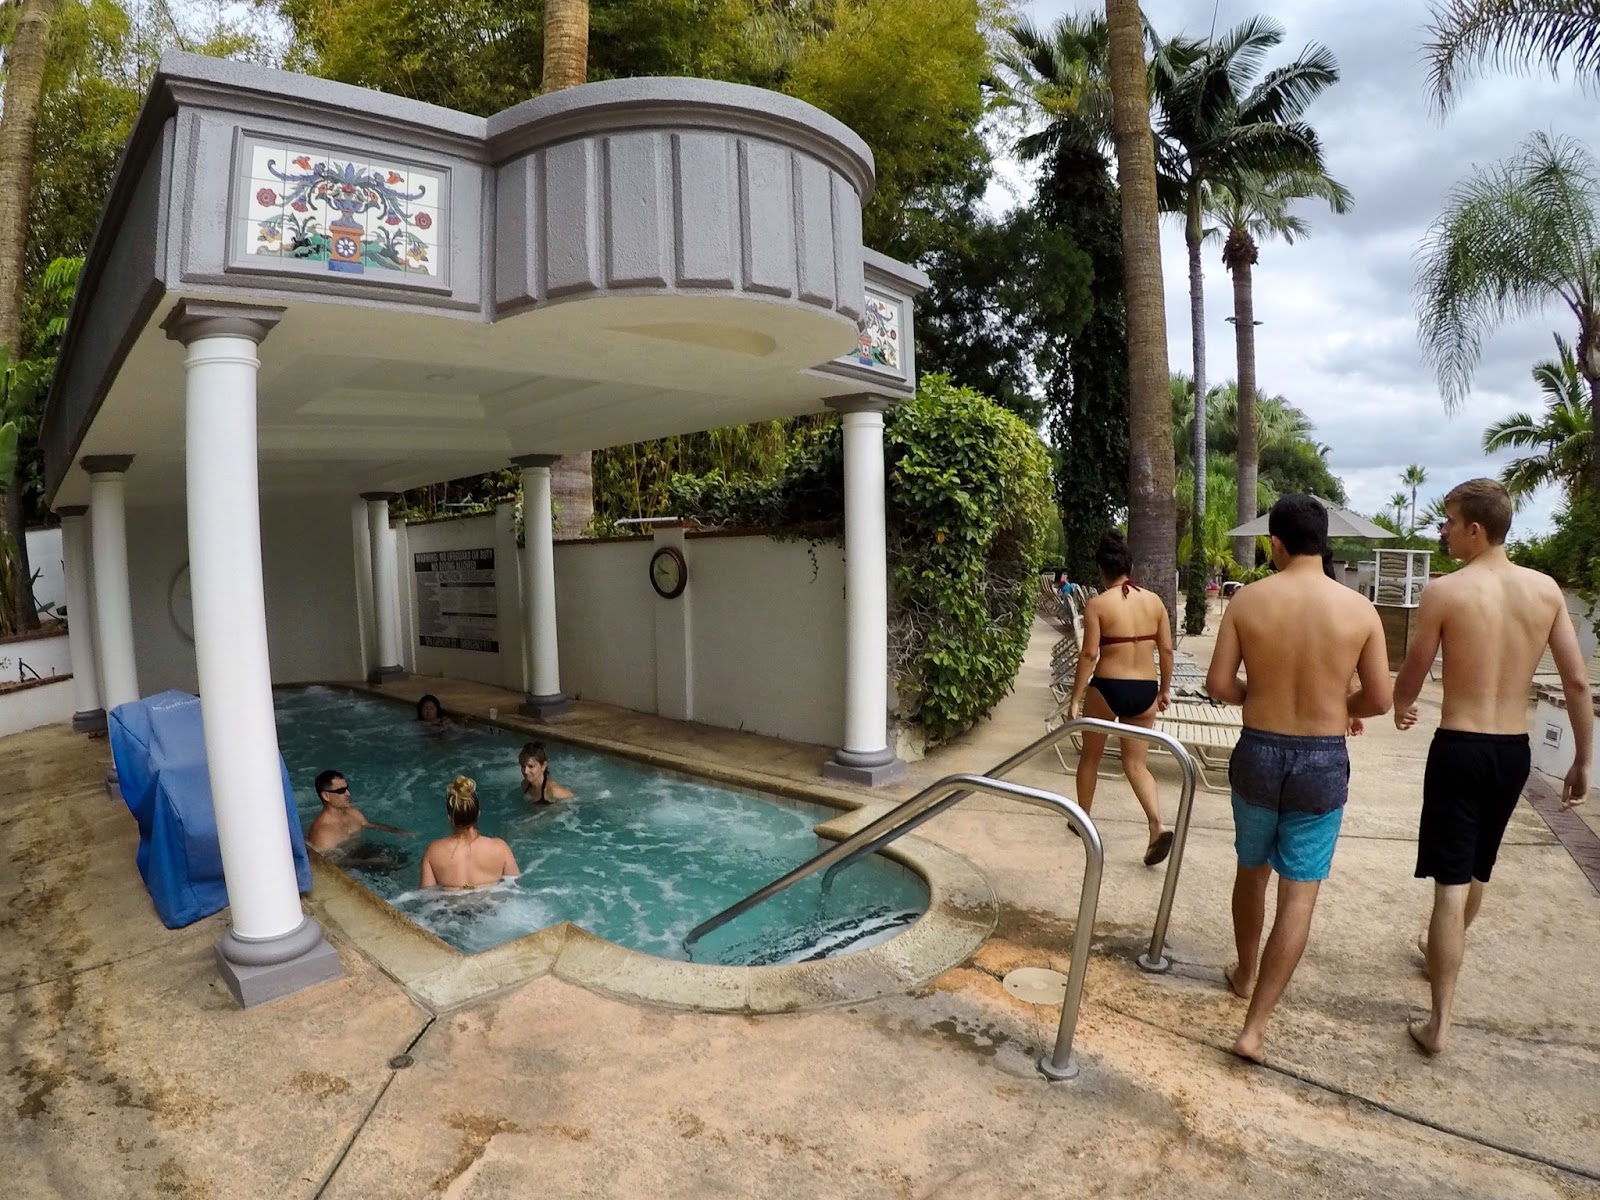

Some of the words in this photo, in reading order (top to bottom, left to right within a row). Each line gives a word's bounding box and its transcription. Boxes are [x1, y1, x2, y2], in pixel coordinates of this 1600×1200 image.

[439, 552, 446, 561] NO
[472, 550, 479, 560] ON
[480, 549, 492, 559] DUTY
[431, 562, 438, 571] NO
[456, 561, 476, 571] ALLOWED
